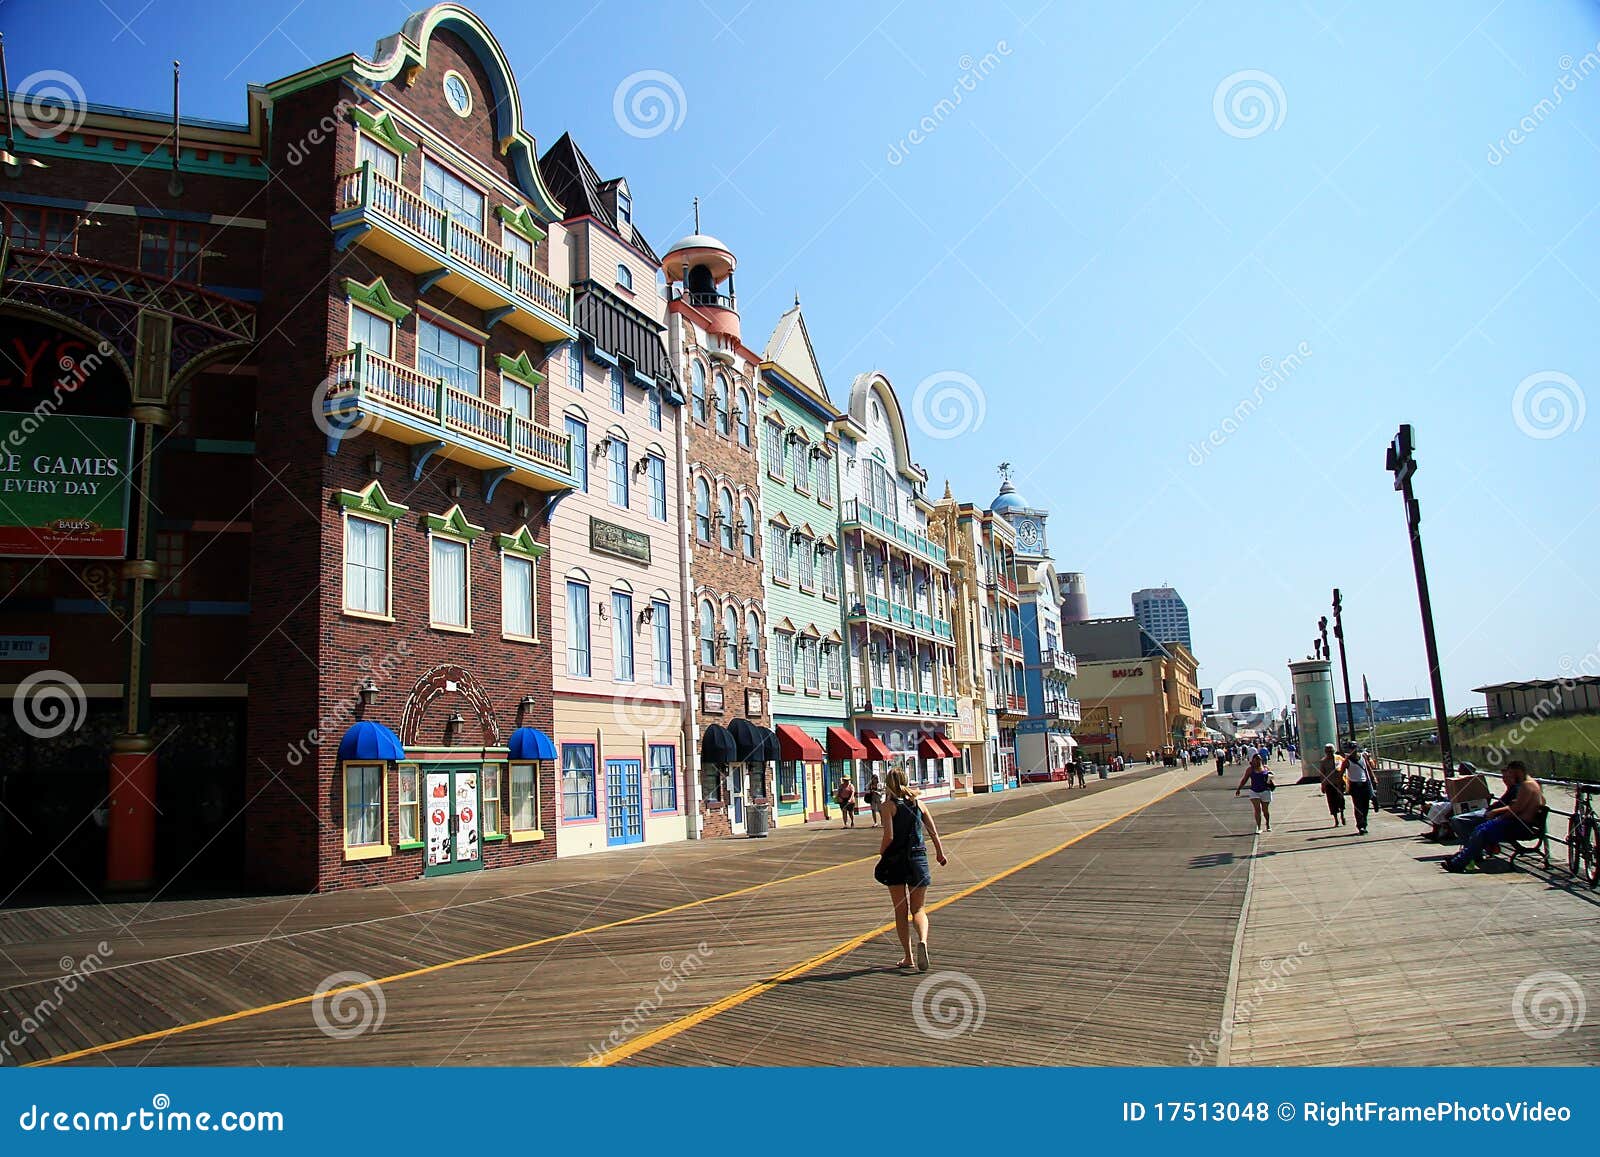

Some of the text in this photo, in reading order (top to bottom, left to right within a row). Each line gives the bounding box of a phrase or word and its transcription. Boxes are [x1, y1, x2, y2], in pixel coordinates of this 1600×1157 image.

[33, 455, 119, 476] GAMES
[3, 478, 101, 495] EVERY DAY
